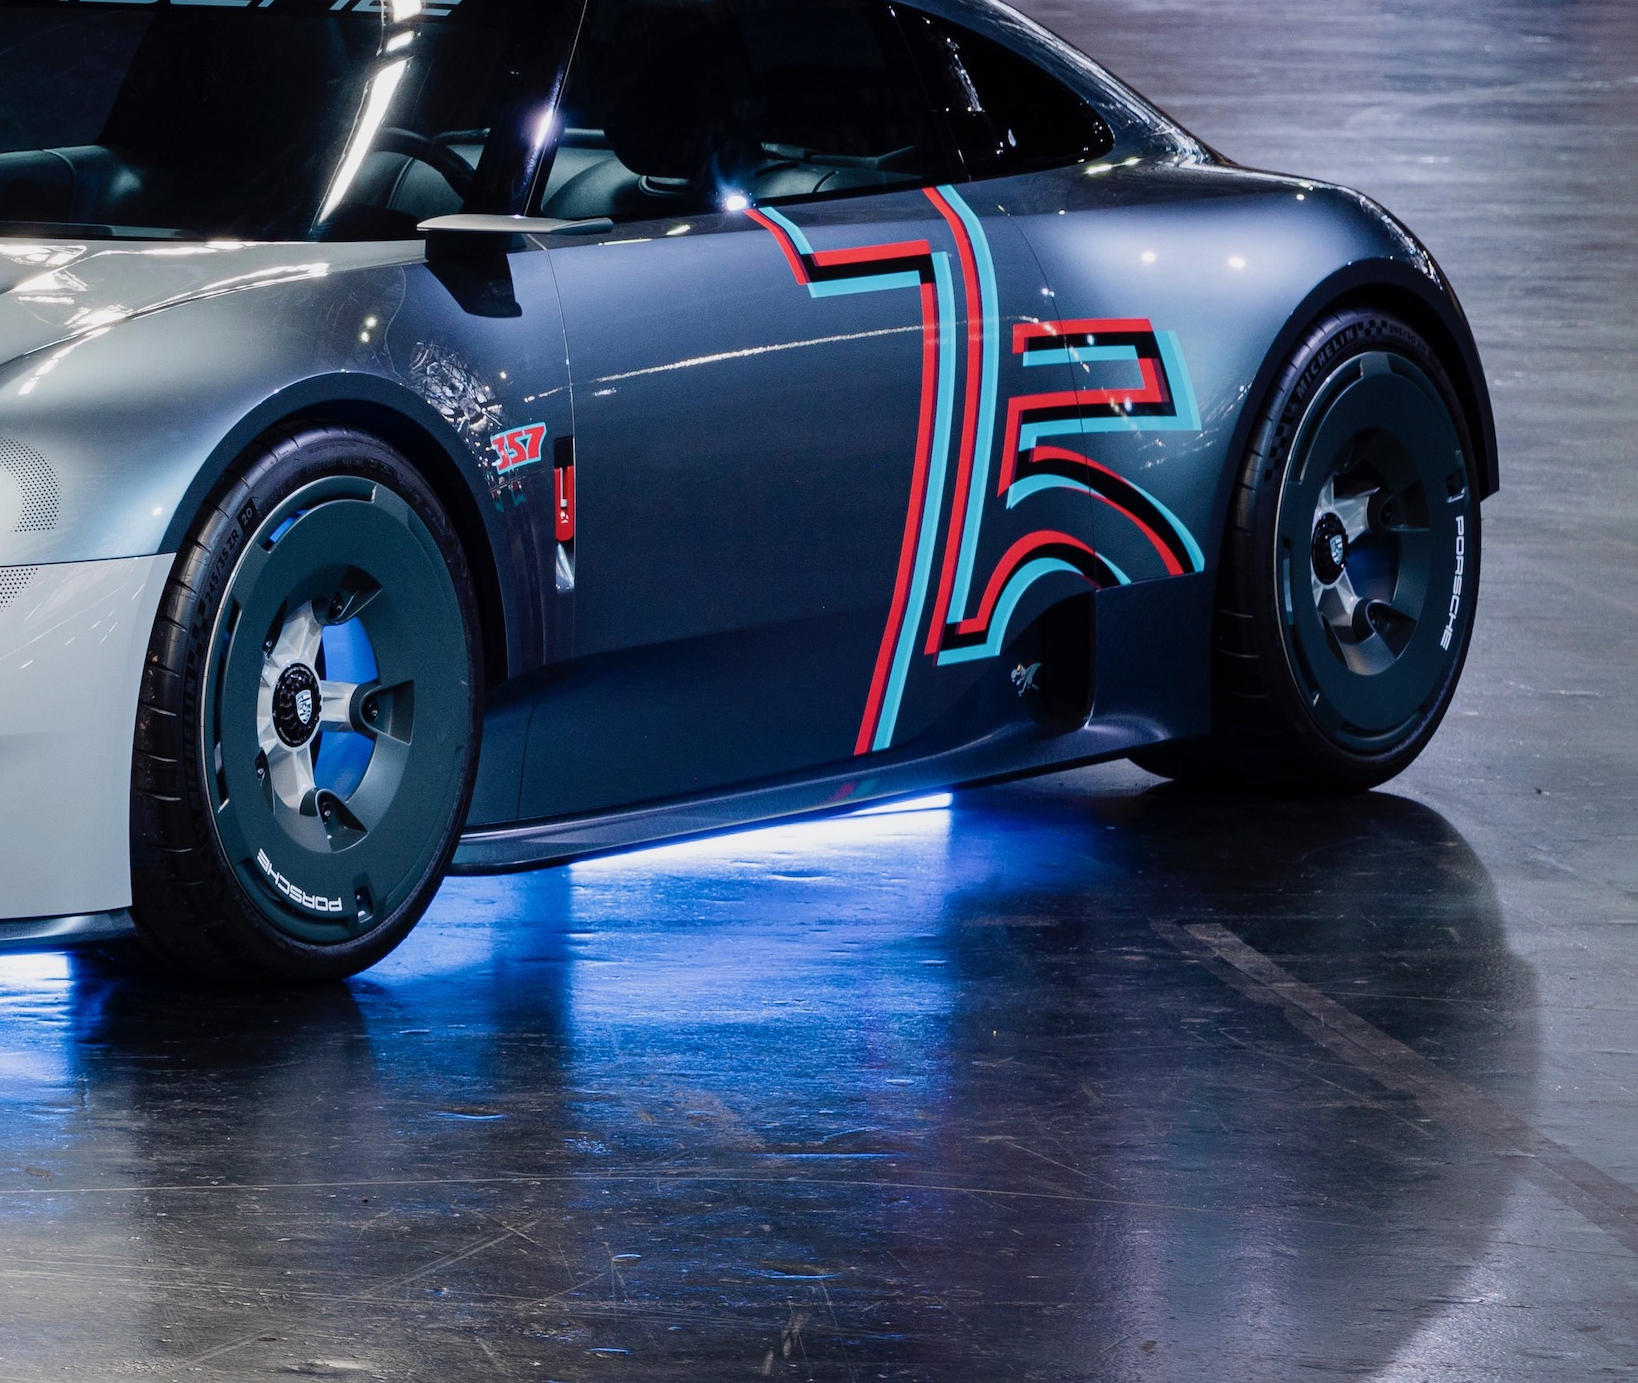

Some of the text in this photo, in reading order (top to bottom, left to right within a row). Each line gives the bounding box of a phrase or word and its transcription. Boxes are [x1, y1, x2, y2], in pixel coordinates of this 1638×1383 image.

[1296, 325, 1357, 399] MICHELIN
[490, 422, 547, 475] 357
[205, 549, 229, 604] 245/35
[227, 529, 240, 549] ZR
[241, 506, 254, 526] 20
[1440, 514, 1465, 652] PORSCHE
[256, 847, 343, 912] PORSCHE
